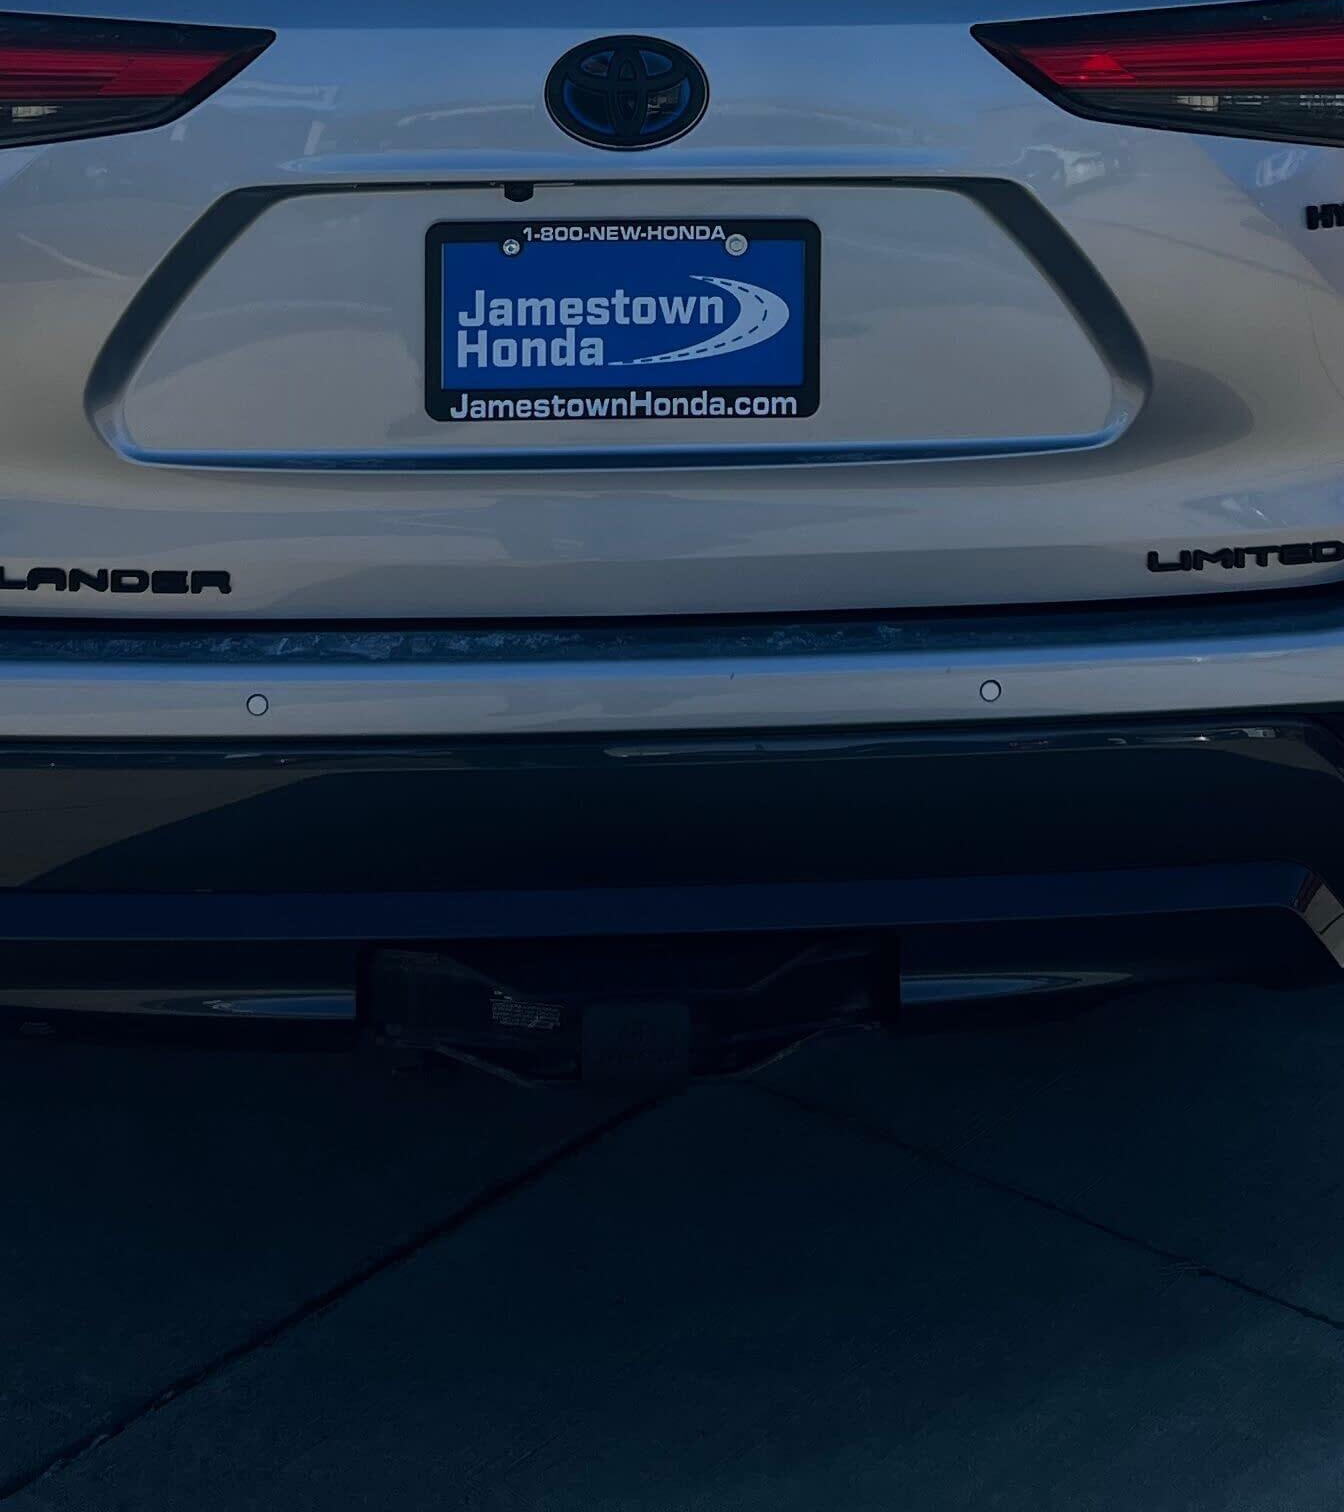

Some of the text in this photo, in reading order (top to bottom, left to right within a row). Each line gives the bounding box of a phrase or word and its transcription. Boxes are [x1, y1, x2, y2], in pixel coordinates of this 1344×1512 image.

[523, 225, 726, 242] 1-800-NEW-HONDA
[458, 289, 724, 327] Jamestown
[457, 328, 605, 368] Honda
[450, 391, 797, 420] JamestownHonda.com
